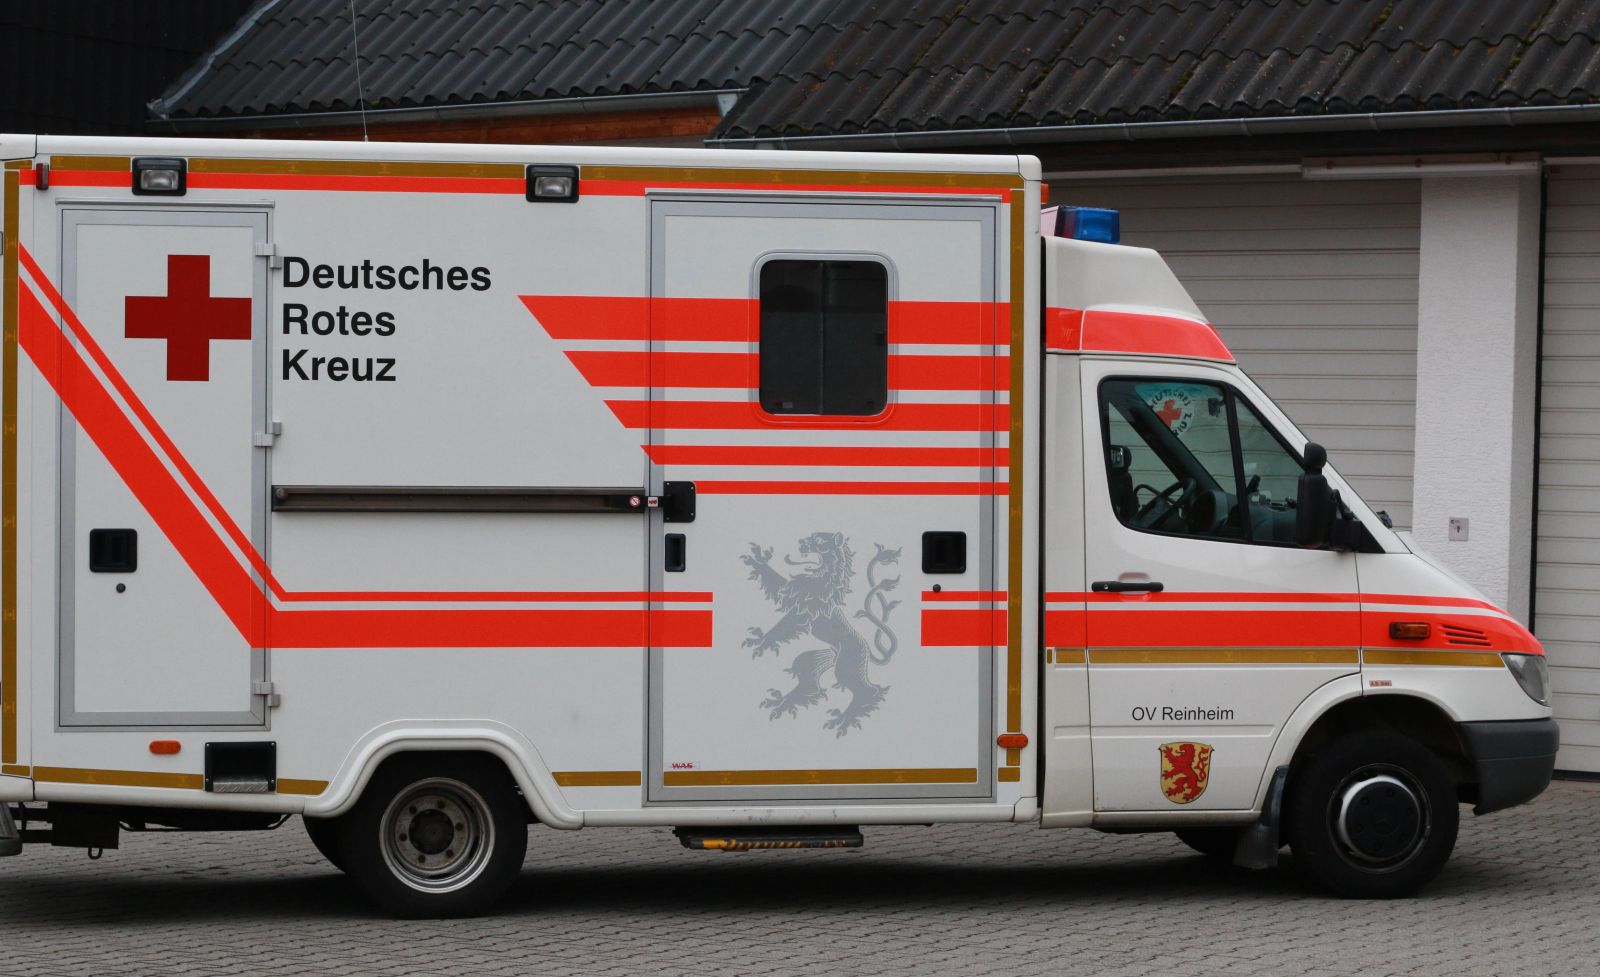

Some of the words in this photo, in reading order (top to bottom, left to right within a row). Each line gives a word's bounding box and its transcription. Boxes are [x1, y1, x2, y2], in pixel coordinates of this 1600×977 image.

[283, 256, 492, 291] Deutsches
[282, 303, 396, 337] Rotes
[282, 349, 396, 382] Kreuz
[1151, 388, 1191, 407] EUTSCHES
[1131, 706, 1157, 721] OV
[1162, 706, 1234, 721] Reinheim
